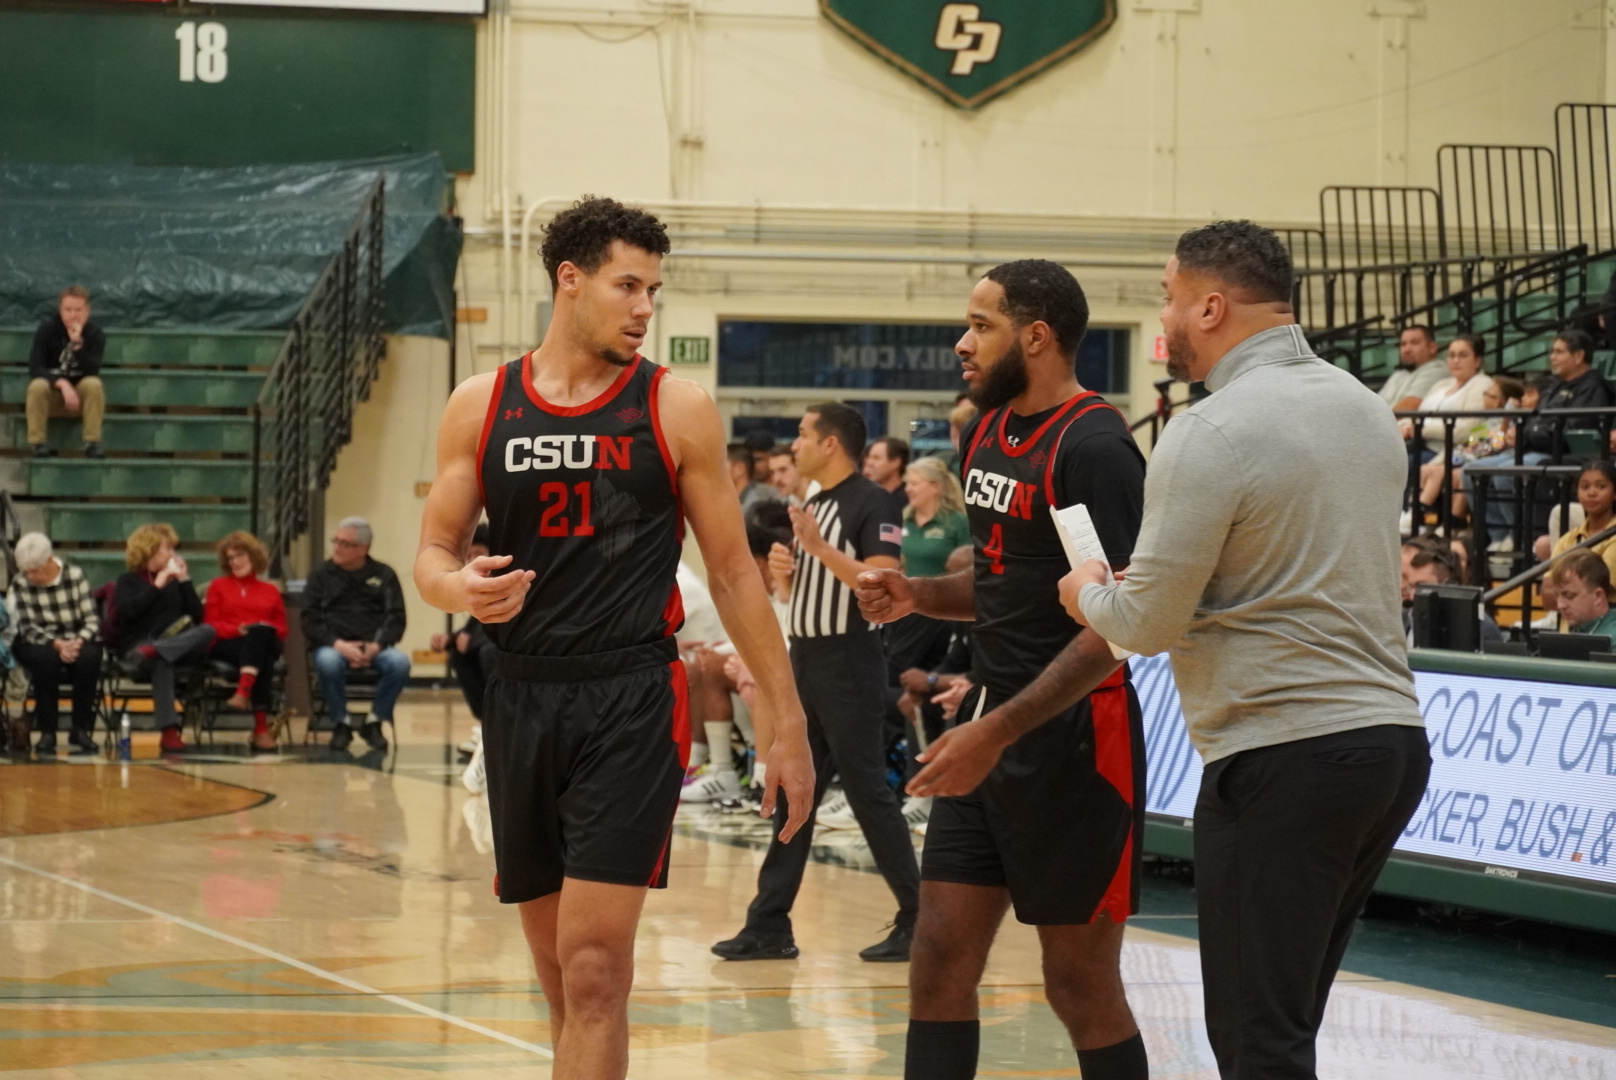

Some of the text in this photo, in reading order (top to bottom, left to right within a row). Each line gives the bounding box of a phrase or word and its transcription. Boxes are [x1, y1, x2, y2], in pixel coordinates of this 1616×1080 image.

[174, 21, 228, 83] 18
[673, 338, 707, 363] EXIT
[505, 434, 634, 473] CSUN
[539, 481, 595, 537] 21
[964, 468, 1037, 520] CSUN
[982, 522, 1005, 575] 4
[1423, 686, 1616, 776] COAST OR
[1495, 798, 1593, 860] BUSH
